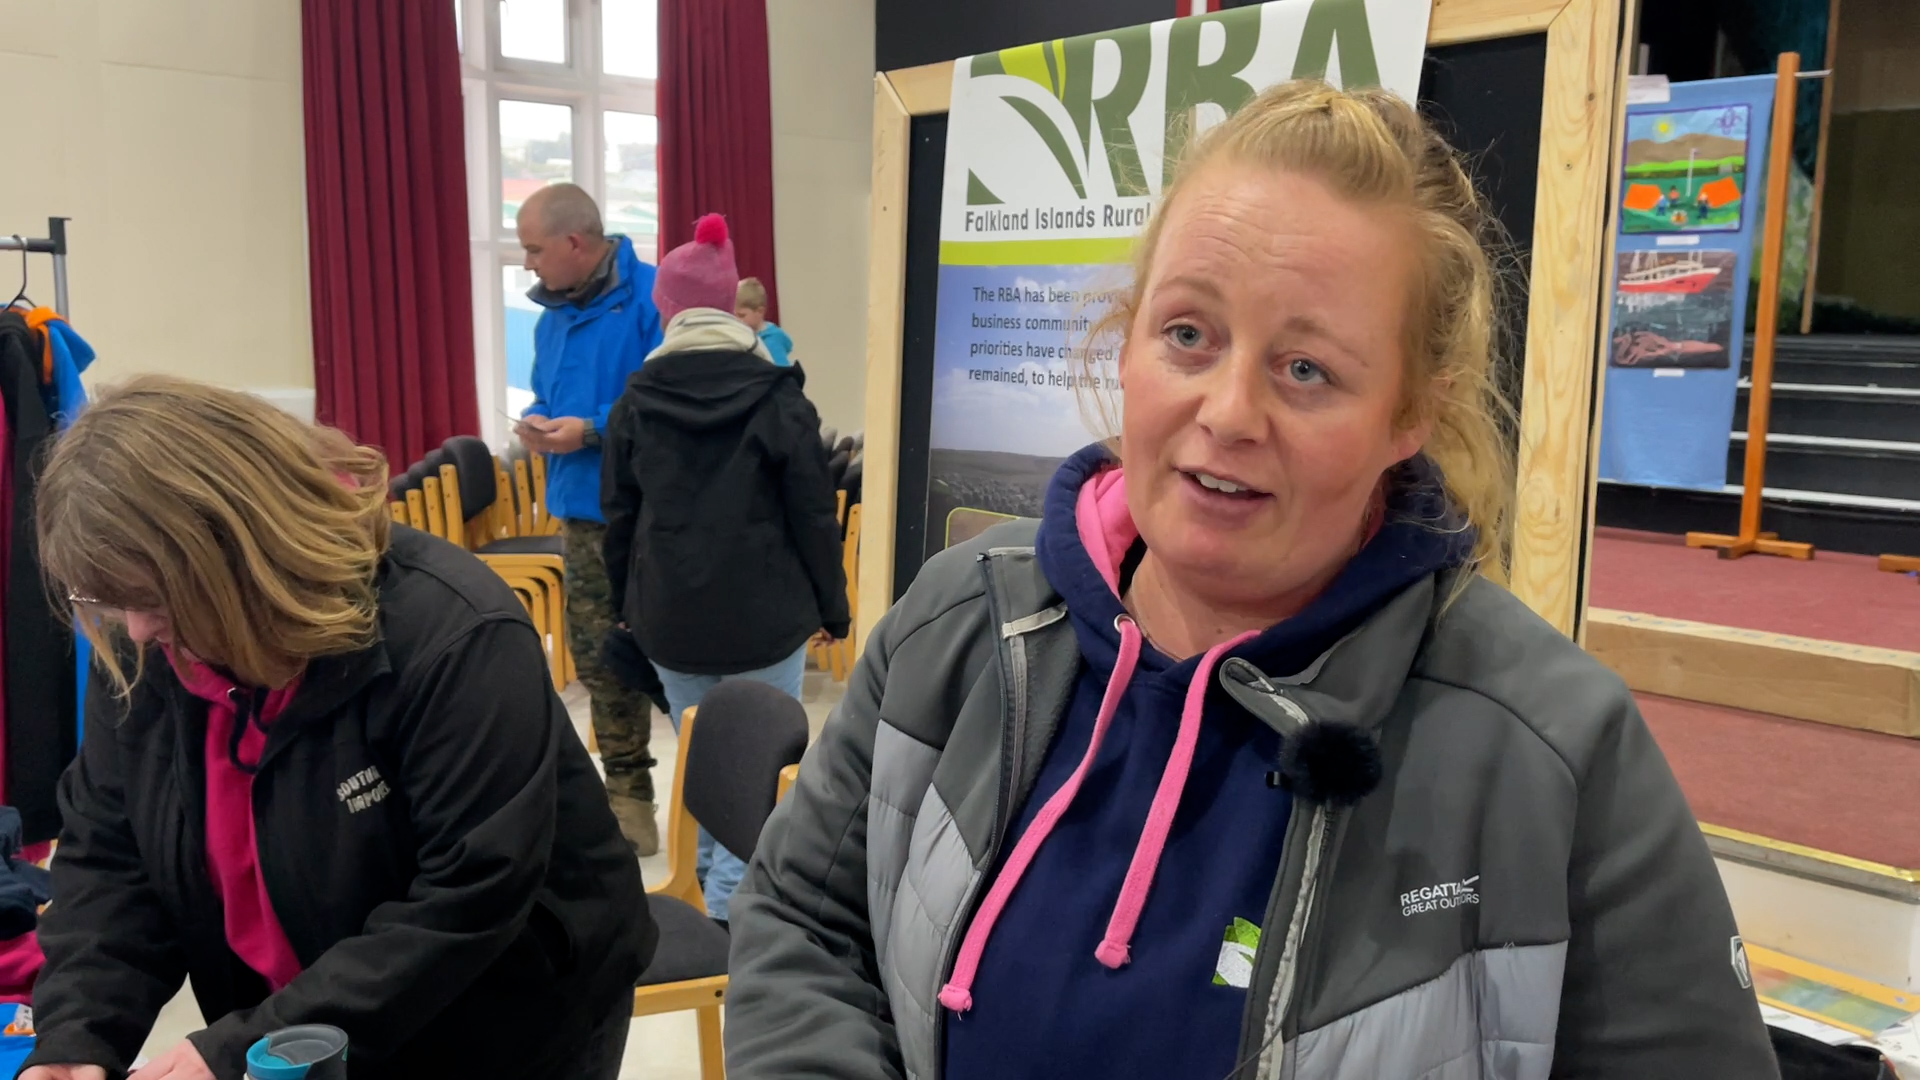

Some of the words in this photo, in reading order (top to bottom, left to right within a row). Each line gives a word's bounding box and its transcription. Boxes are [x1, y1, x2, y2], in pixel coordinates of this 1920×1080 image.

[965, 208, 1029, 232] Falkland
[1036, 205, 1096, 230] Islands
[1103, 202, 1151, 228] Rural
[973, 287, 995, 302] The
[998, 287, 1021, 302] RBA
[1024, 287, 1045, 303] has
[1049, 286, 1080, 303] been
[972, 312, 1021, 330] business
[1025, 316, 1089, 331] communit
[970, 341, 1023, 359] priorities
[1026, 343, 1055, 359] have
[969, 368, 1029, 387] remained,
[1032, 371, 1045, 386] to
[1048, 370, 1074, 391] help
[1402, 899, 1438, 917] GREAT
